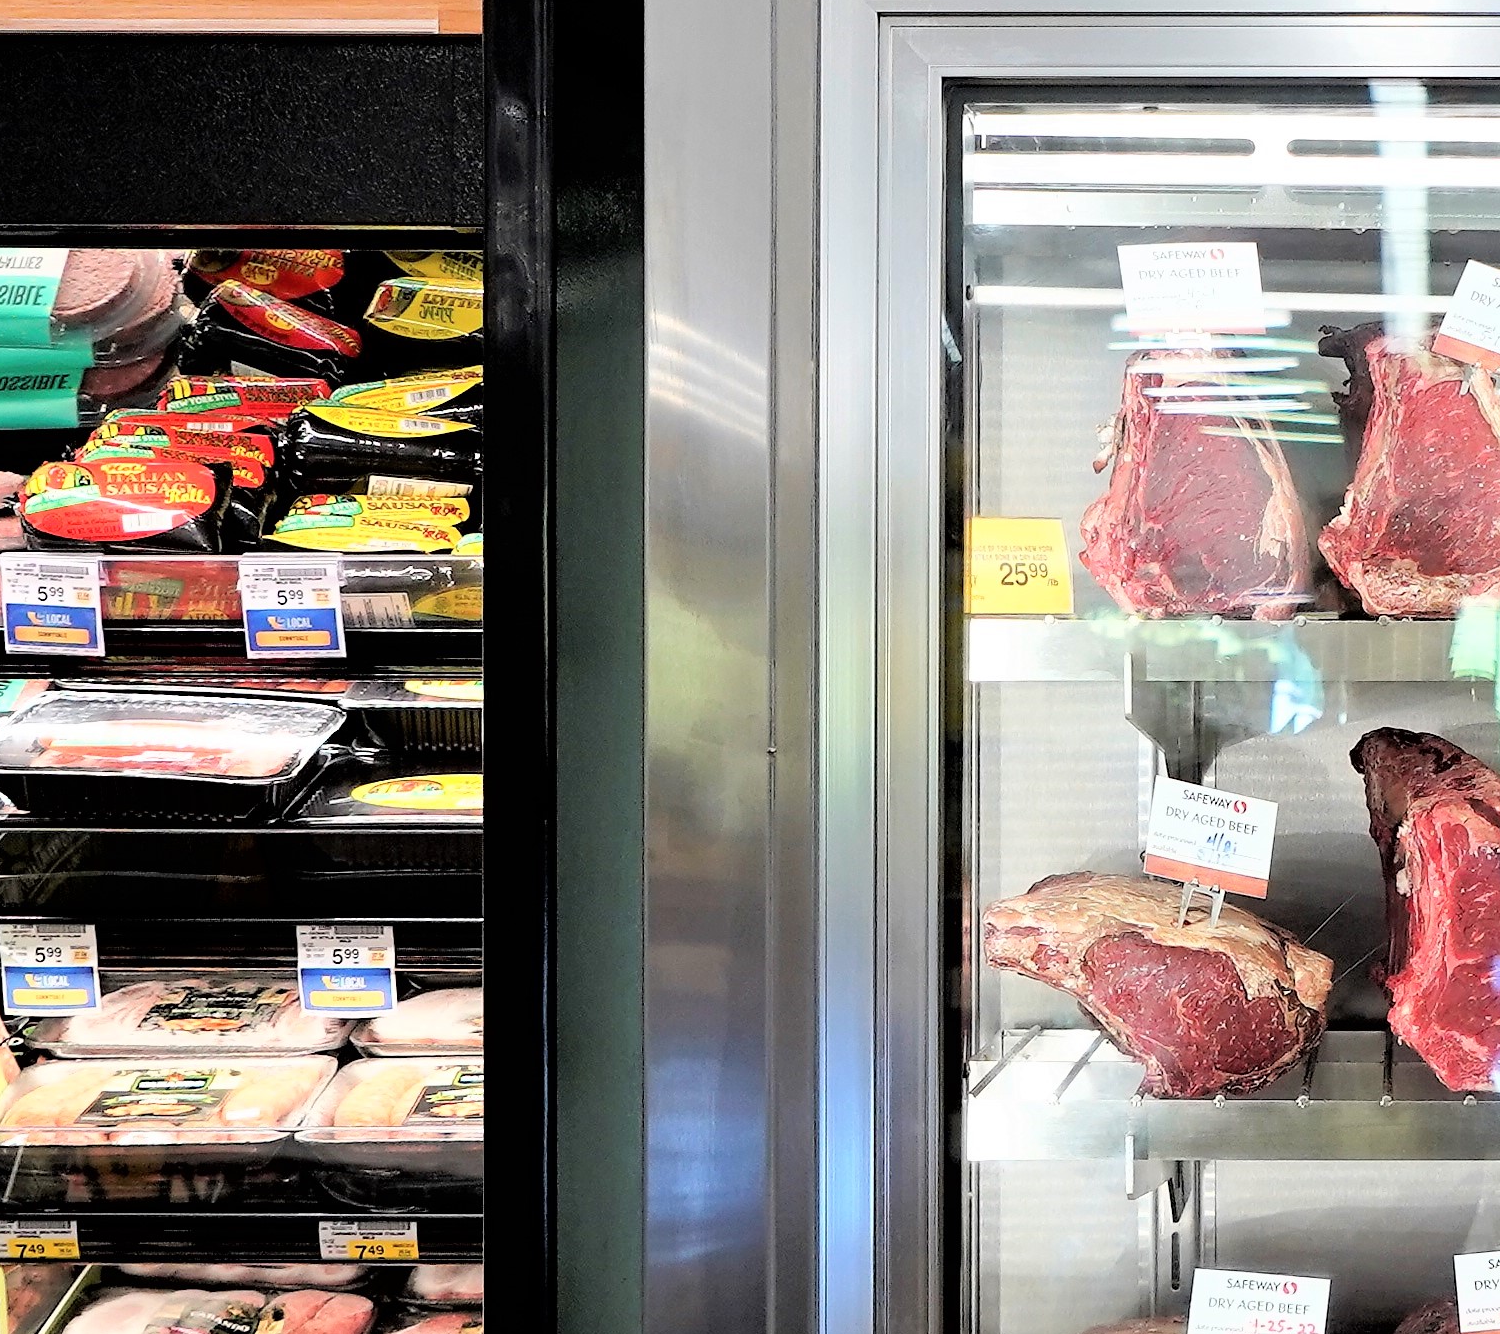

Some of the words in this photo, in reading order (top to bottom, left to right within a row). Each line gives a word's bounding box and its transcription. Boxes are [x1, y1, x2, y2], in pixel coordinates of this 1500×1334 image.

[1153, 250, 1207, 261] SAFEWAY
[1471, 290, 1495, 310] DRY
[106, 471, 187, 484] ITALIAN
[1182, 789, 1232, 810] SAFEWAY
[1166, 807, 1190, 823] DRY
[1192, 812, 1226, 829] AGED
[1229, 819, 1259, 836] BEEF
[1226, 1278, 1281, 1293] SAFEWAY
[1474, 1277, 1500, 1292] DRY
[1208, 1296, 1236, 1311] DRY
[1238, 1299, 1275, 1313] AGED
[1278, 1302, 1311, 1316] BEEF
